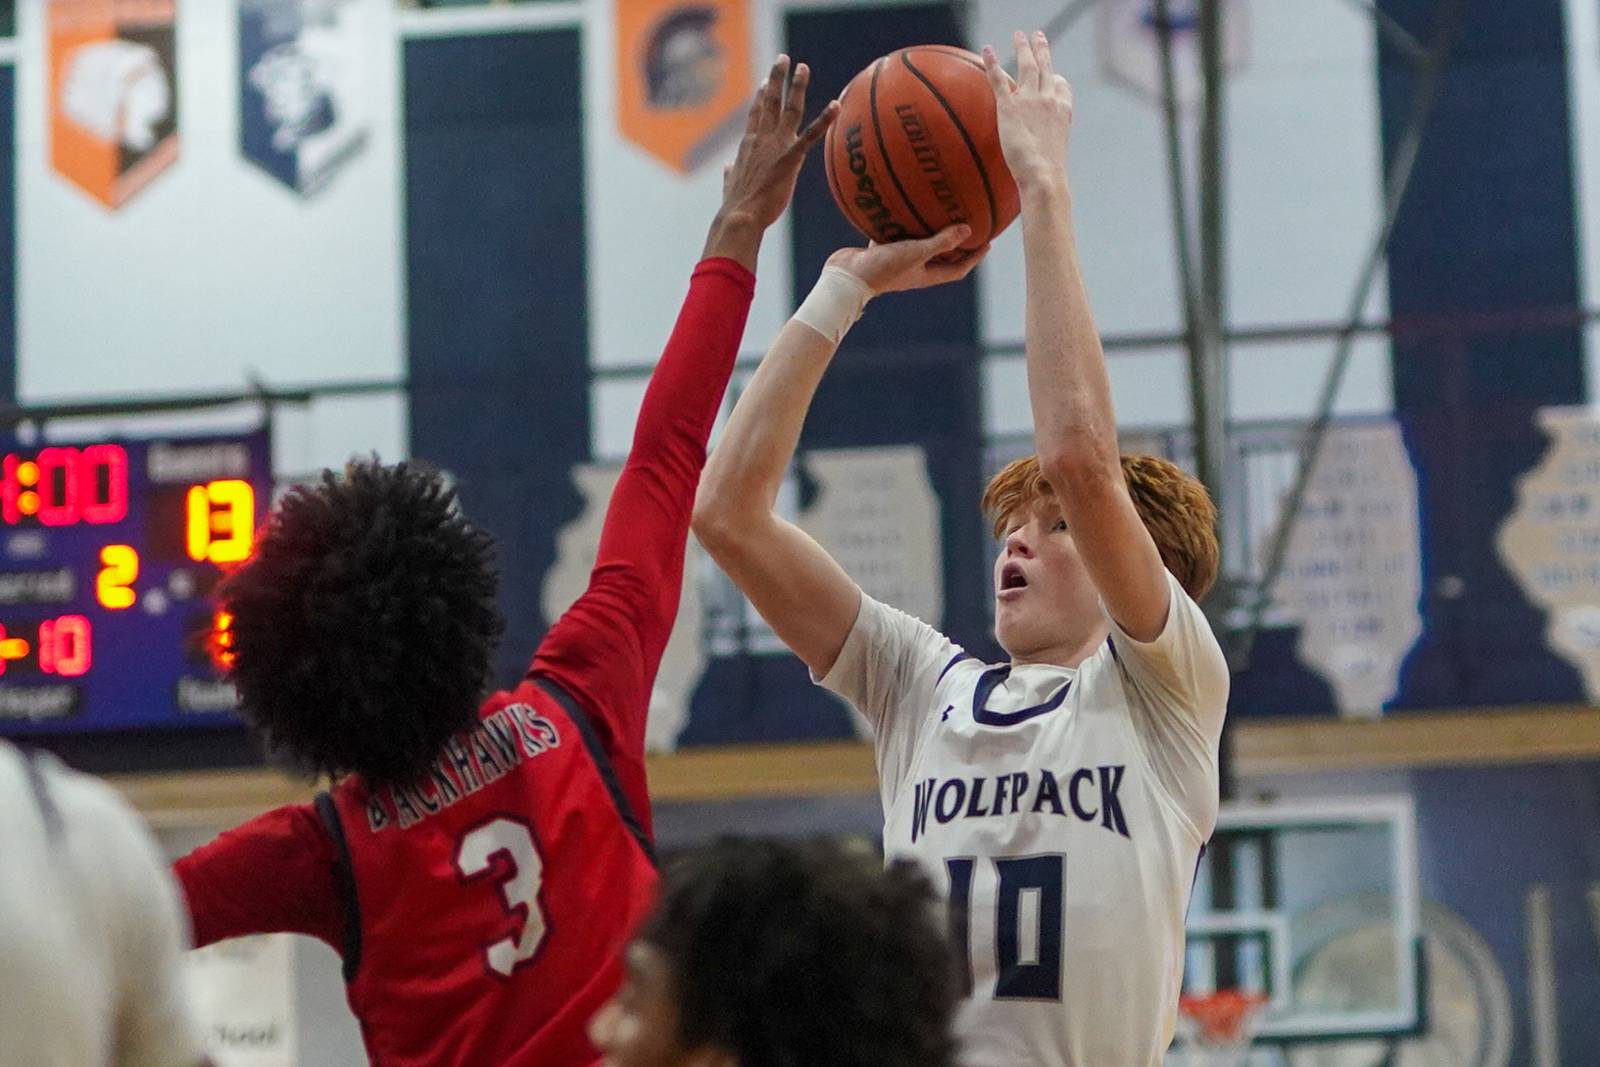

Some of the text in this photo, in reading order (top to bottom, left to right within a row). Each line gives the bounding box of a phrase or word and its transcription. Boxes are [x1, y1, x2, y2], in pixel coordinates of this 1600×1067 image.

[185, 479, 256, 564] 13
[96, 543, 140, 610] 2
[366, 702, 560, 833] ACKHAWKS
[911, 764, 1131, 844] WOLFPACK
[456, 815, 549, 978] 3
[943, 852, 1067, 1003] 10
